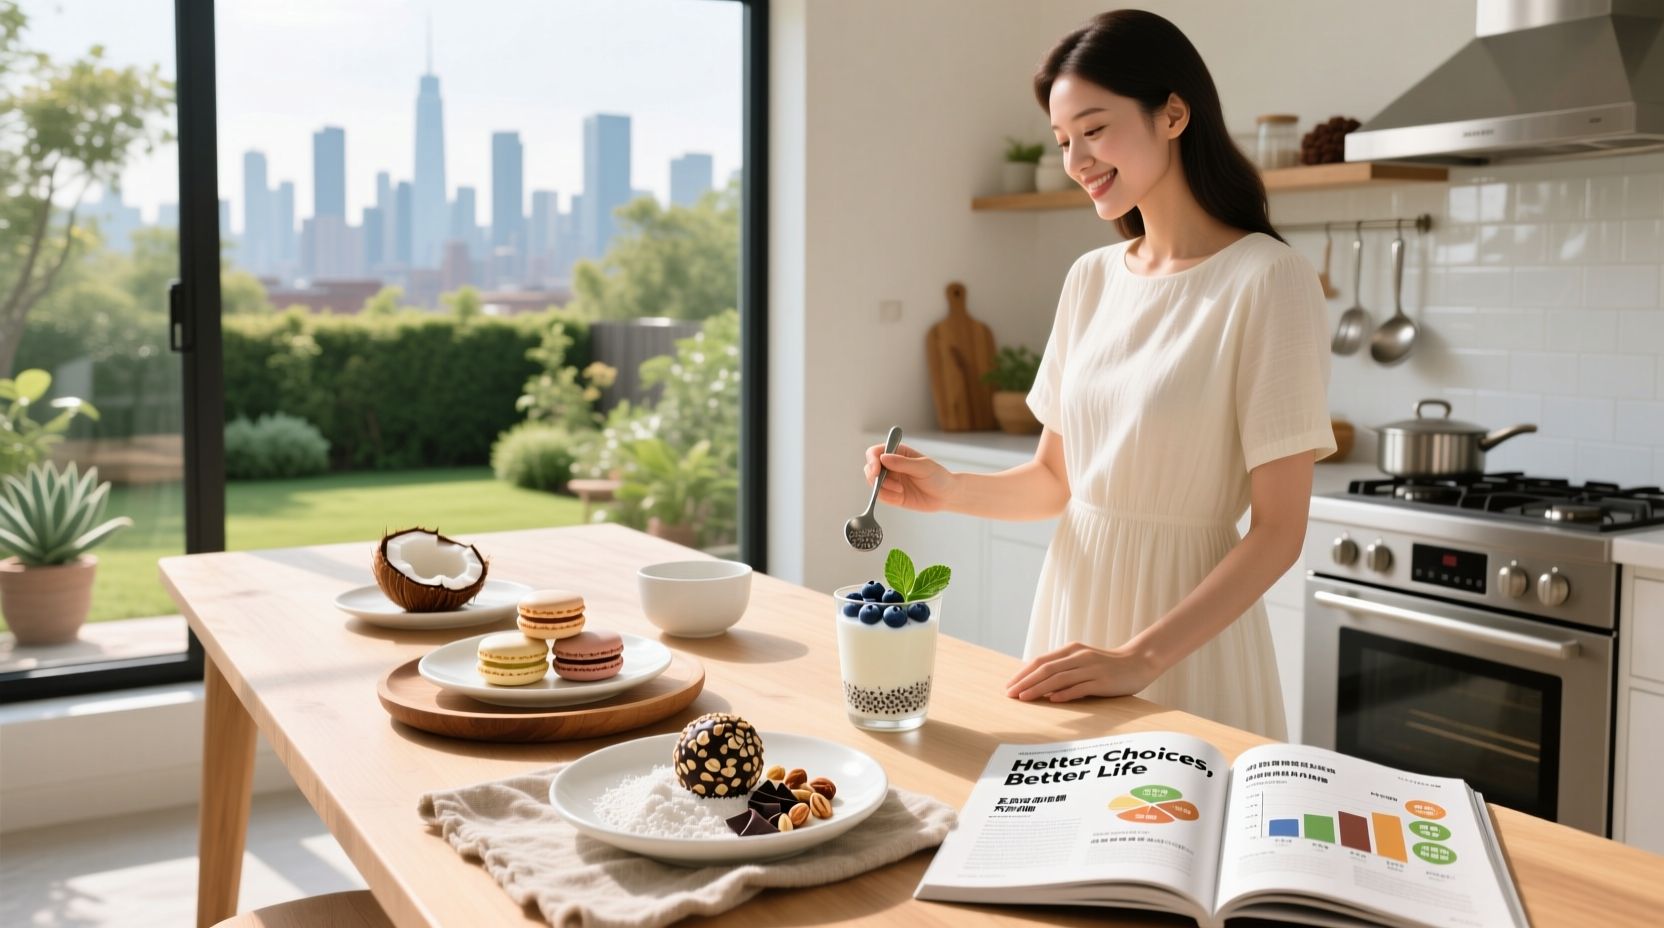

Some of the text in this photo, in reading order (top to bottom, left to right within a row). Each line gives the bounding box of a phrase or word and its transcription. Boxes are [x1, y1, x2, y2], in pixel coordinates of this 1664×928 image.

[1004, 761, 1148, 786] Better Life
[1102, 747, 1214, 778] Choices,
